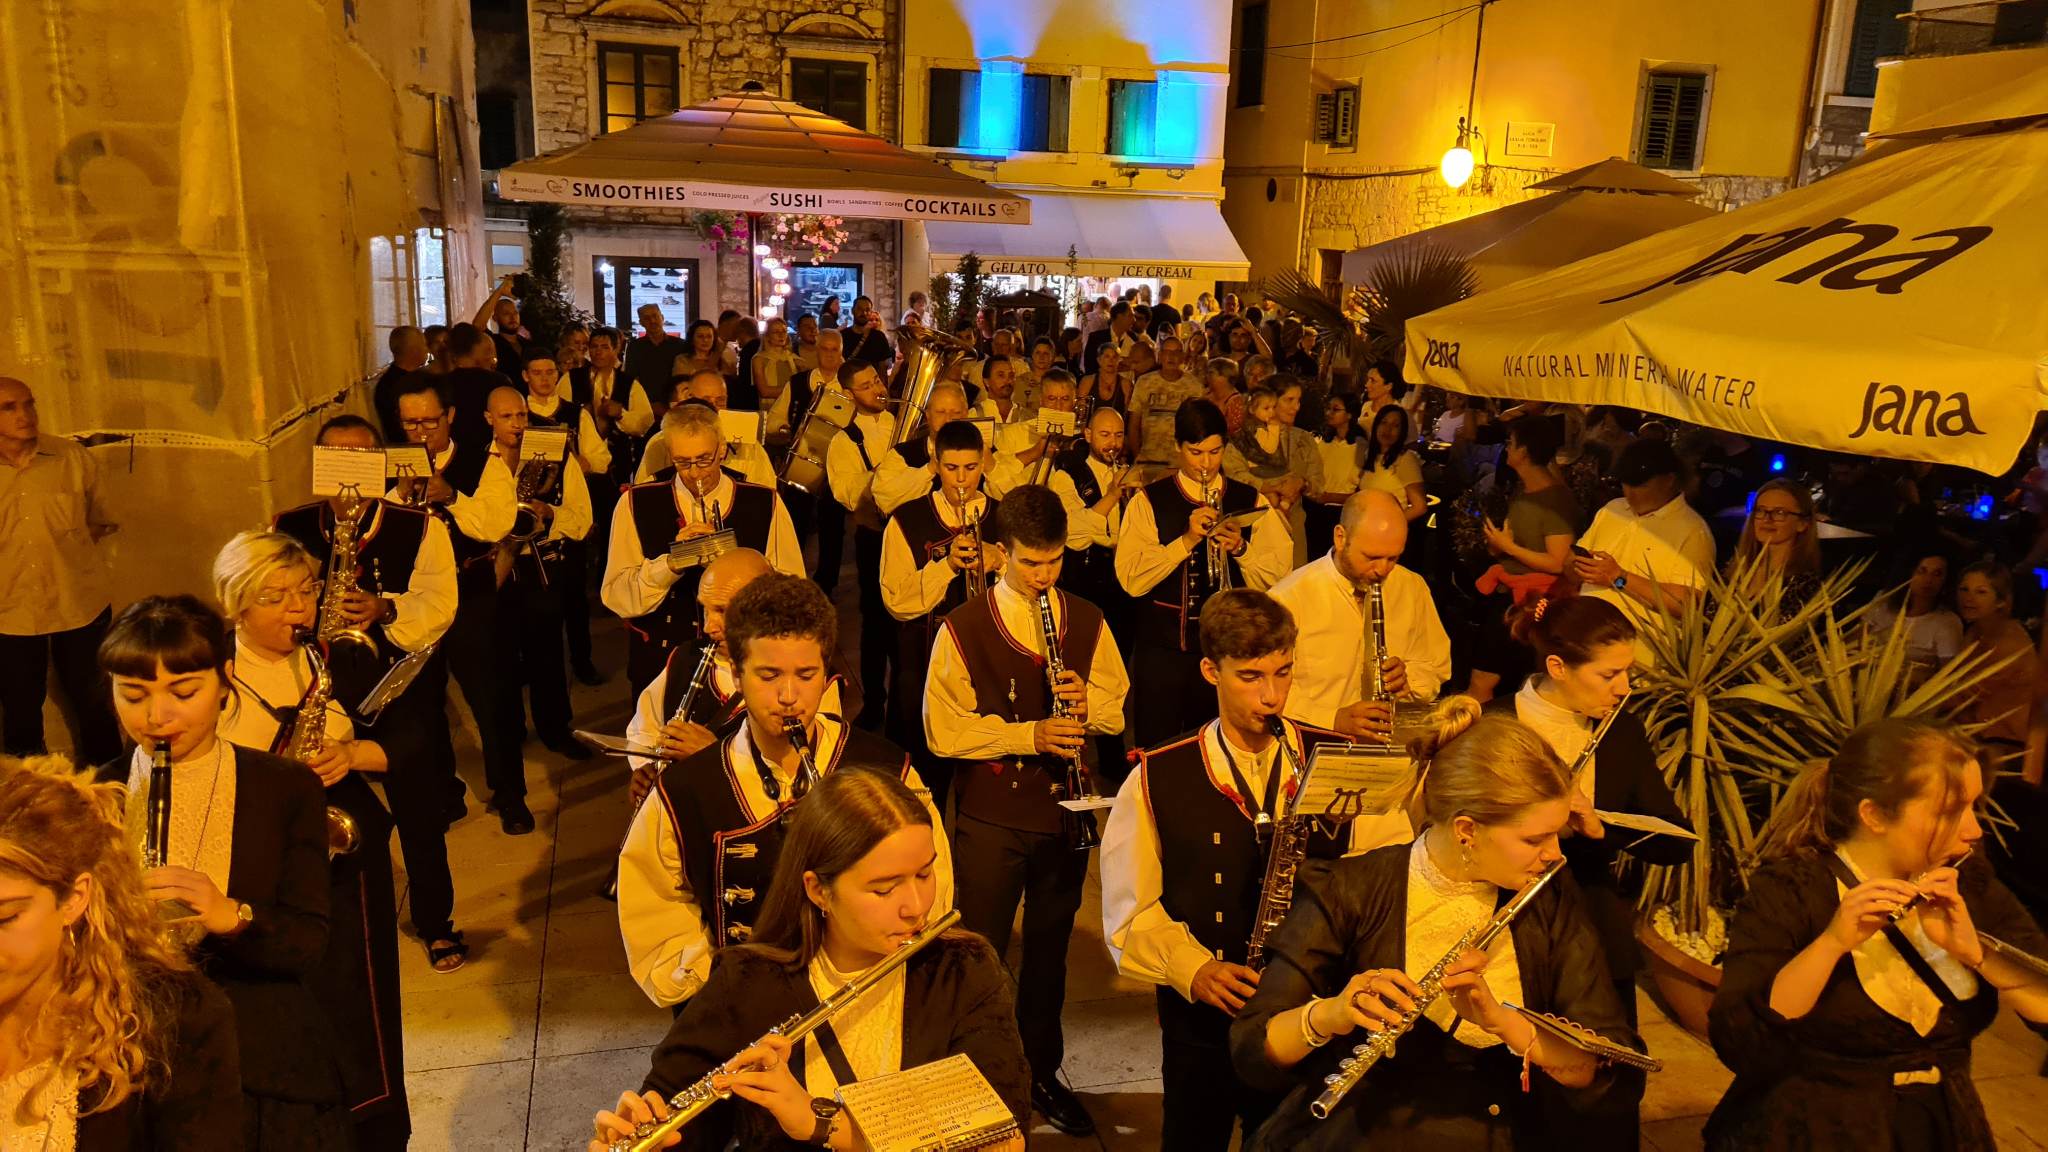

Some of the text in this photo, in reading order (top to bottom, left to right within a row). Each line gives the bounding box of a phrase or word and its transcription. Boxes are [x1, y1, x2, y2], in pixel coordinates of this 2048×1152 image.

[573, 182, 685, 201] SMOOTHIES
[770, 192, 822, 208] SUSHI
[904, 198, 996, 217] COCKTAILS
[991, 262, 1046, 274] GELATO
[1121, 265, 1192, 279] ICE CREAM
[1504, 353, 1756, 409] NATURAL MINERA WATER
